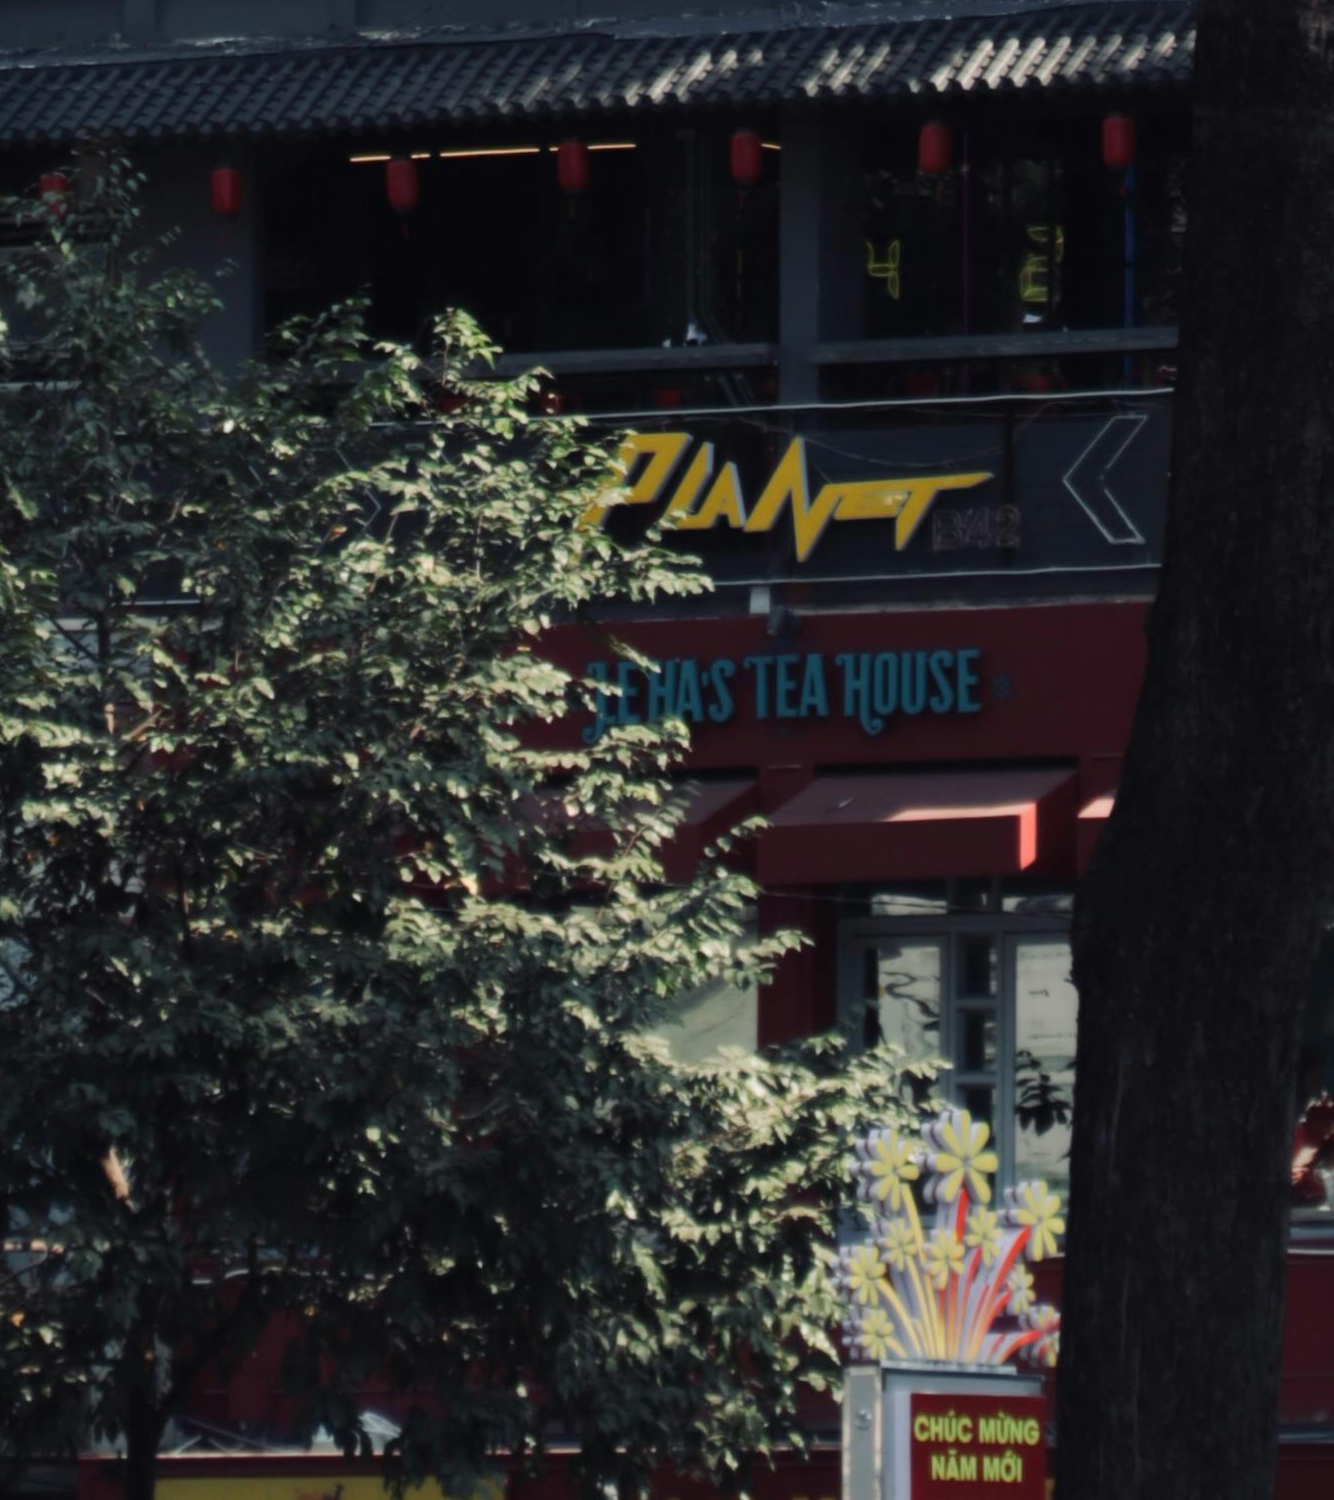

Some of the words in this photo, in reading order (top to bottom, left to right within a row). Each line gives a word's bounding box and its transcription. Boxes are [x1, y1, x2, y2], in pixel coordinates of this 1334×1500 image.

[931, 507, 1021, 553] B42
[742, 653, 830, 718] TEA
[834, 647, 983, 736] HOUSE
[913, 1409, 974, 1444] CHÚC
[978, 1409, 1041, 1446] MỪNG
[930, 1448, 978, 1482] NĂM
[982, 1448, 1024, 1484] MỚI
